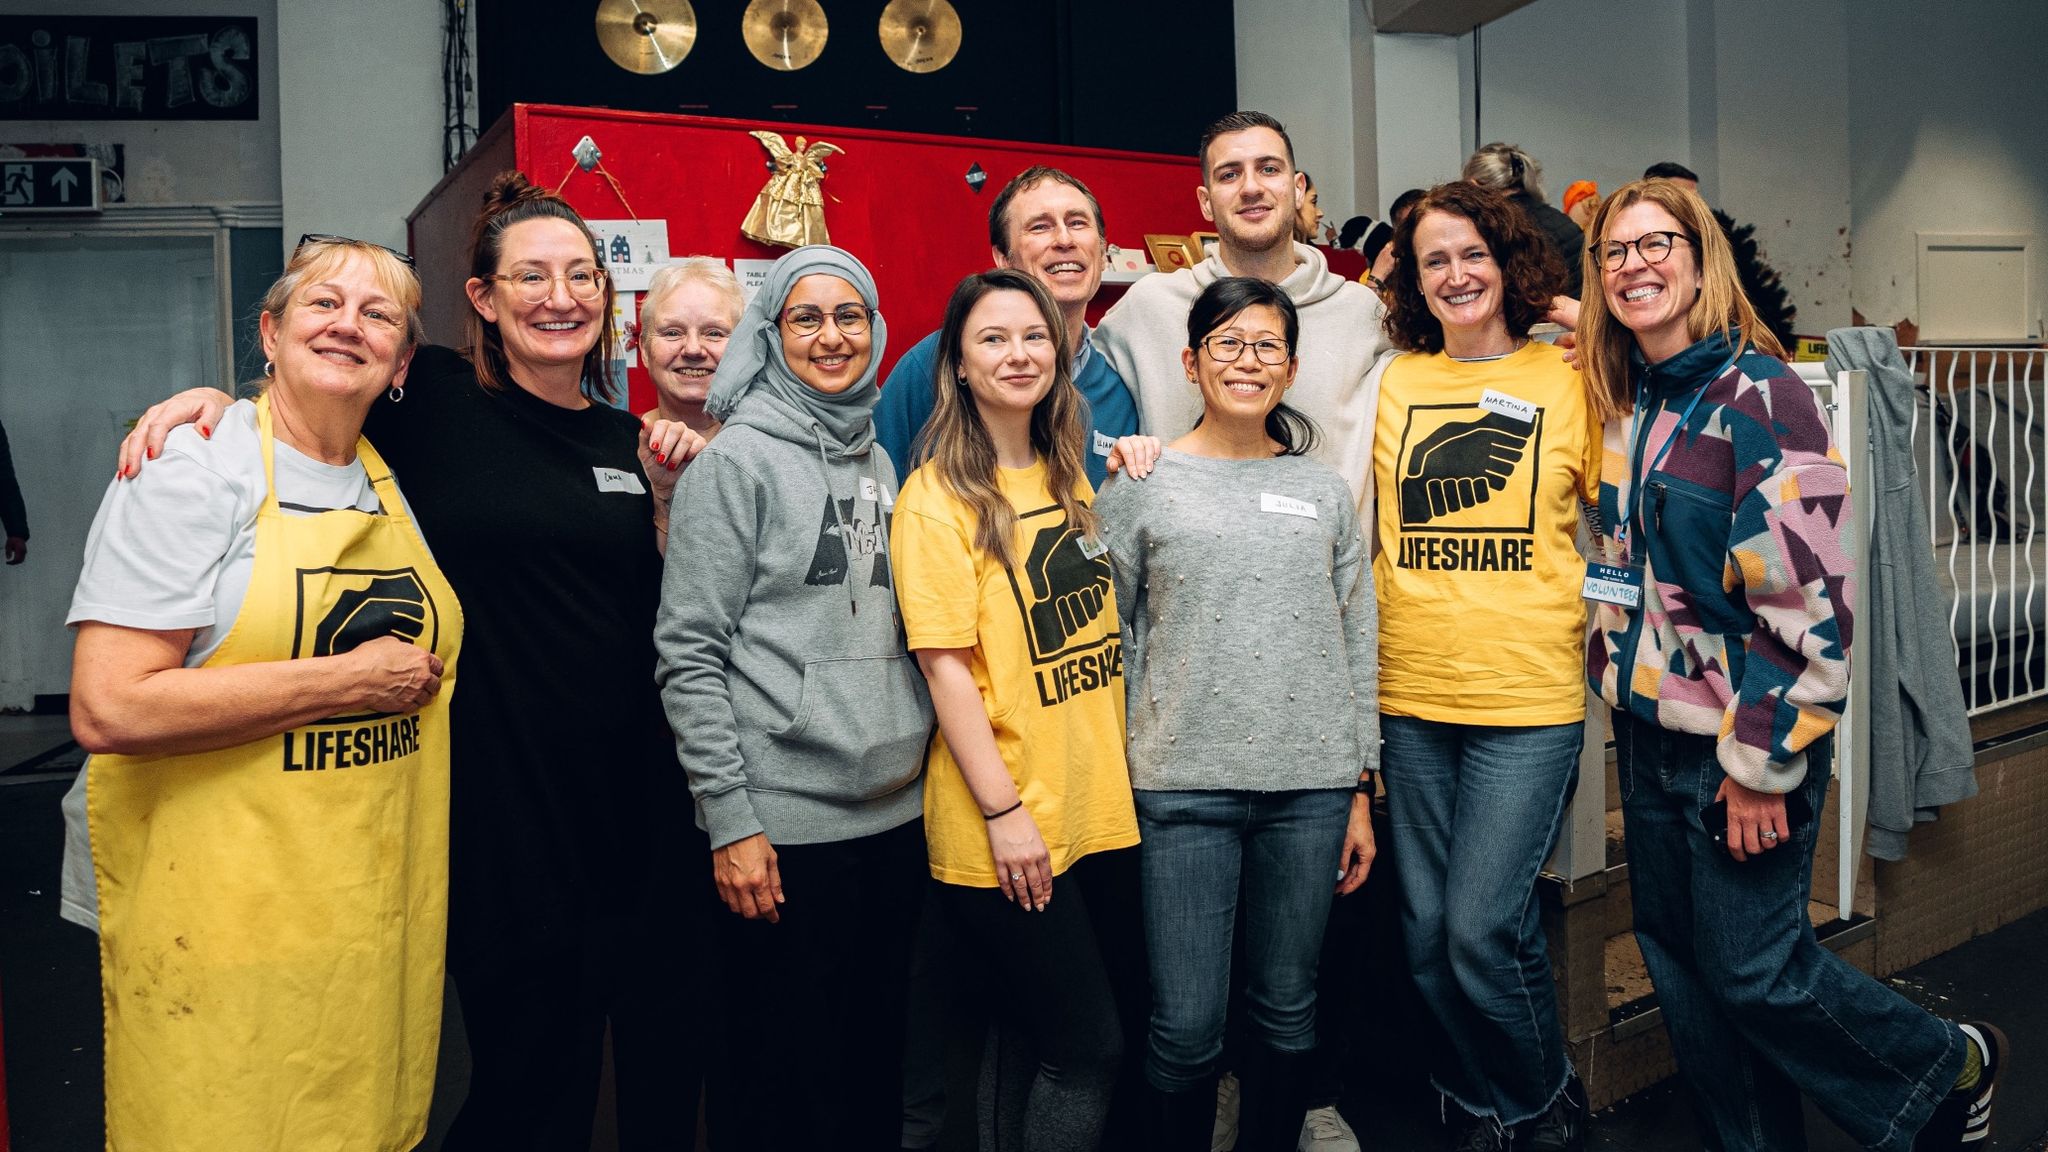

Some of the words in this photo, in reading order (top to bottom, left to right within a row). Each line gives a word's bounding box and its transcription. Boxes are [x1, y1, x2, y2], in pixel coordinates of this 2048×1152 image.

[1484, 396, 1528, 414] MARTINA
[1397, 537, 1534, 571] LIFESHARE
[1600, 567, 1630, 578] HELLO
[1586, 581, 1638, 602] VOLUNTEER
[283, 715, 420, 771] LIFESHARE
